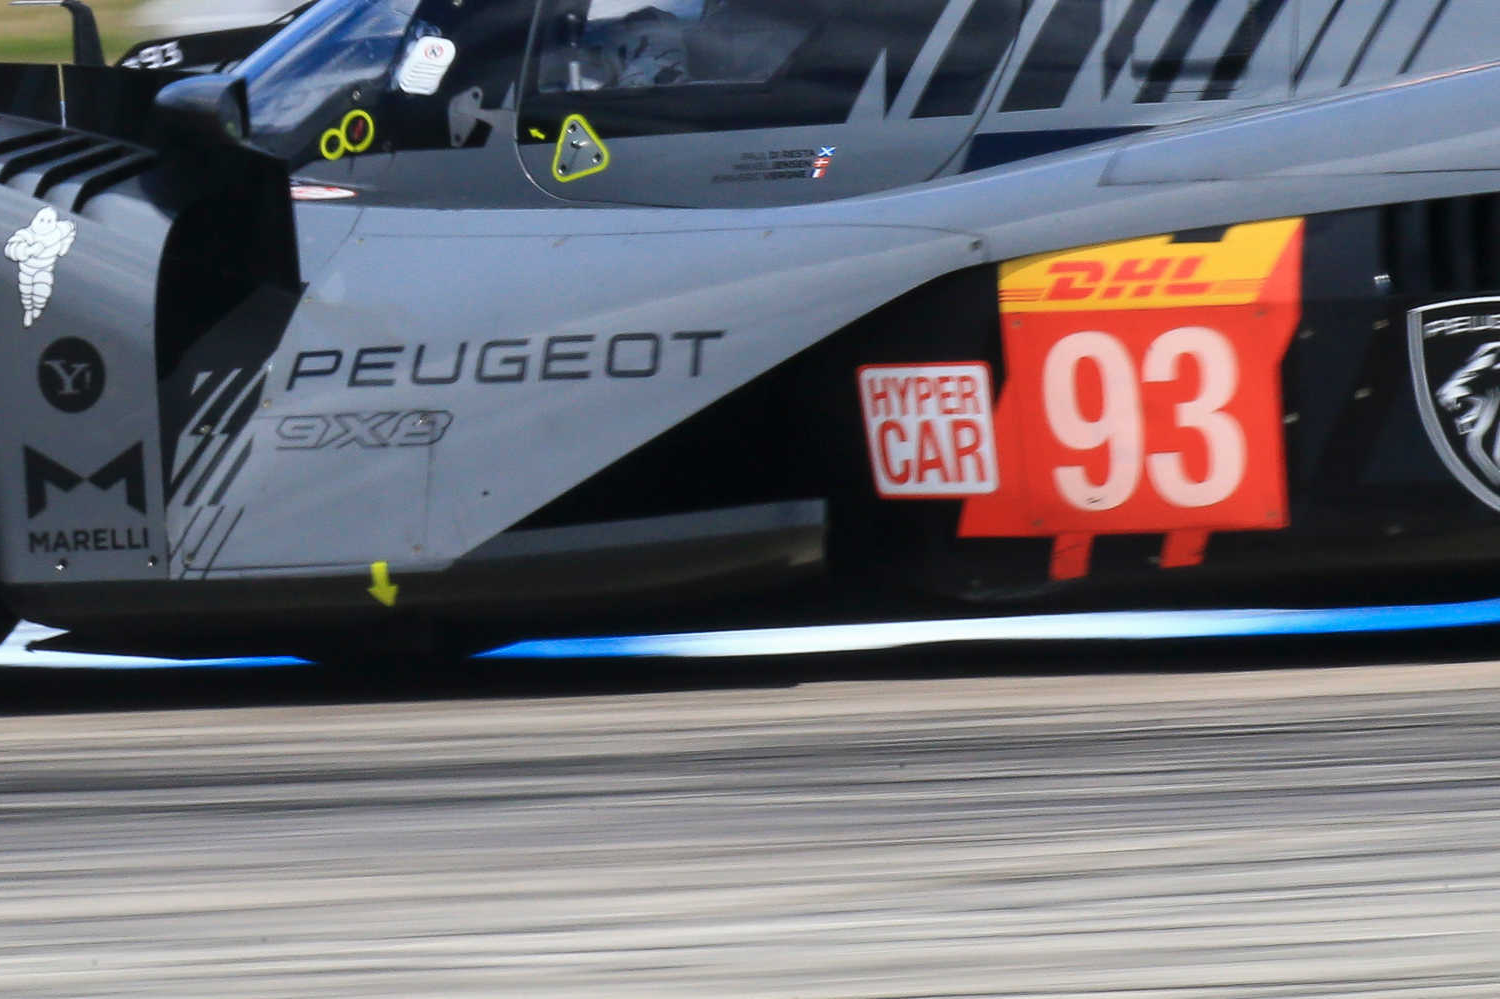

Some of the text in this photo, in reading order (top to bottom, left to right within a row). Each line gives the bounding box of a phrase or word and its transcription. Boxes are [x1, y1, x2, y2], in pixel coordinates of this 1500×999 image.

[1044, 256, 1213, 301] DHL
[286, 330, 726, 391] PEUGEOT
[867, 375, 981, 417] HYPER
[1043, 326, 1248, 512] 93
[878, 418, 987, 486] CAR
[27, 527, 149, 554] MARELLI
